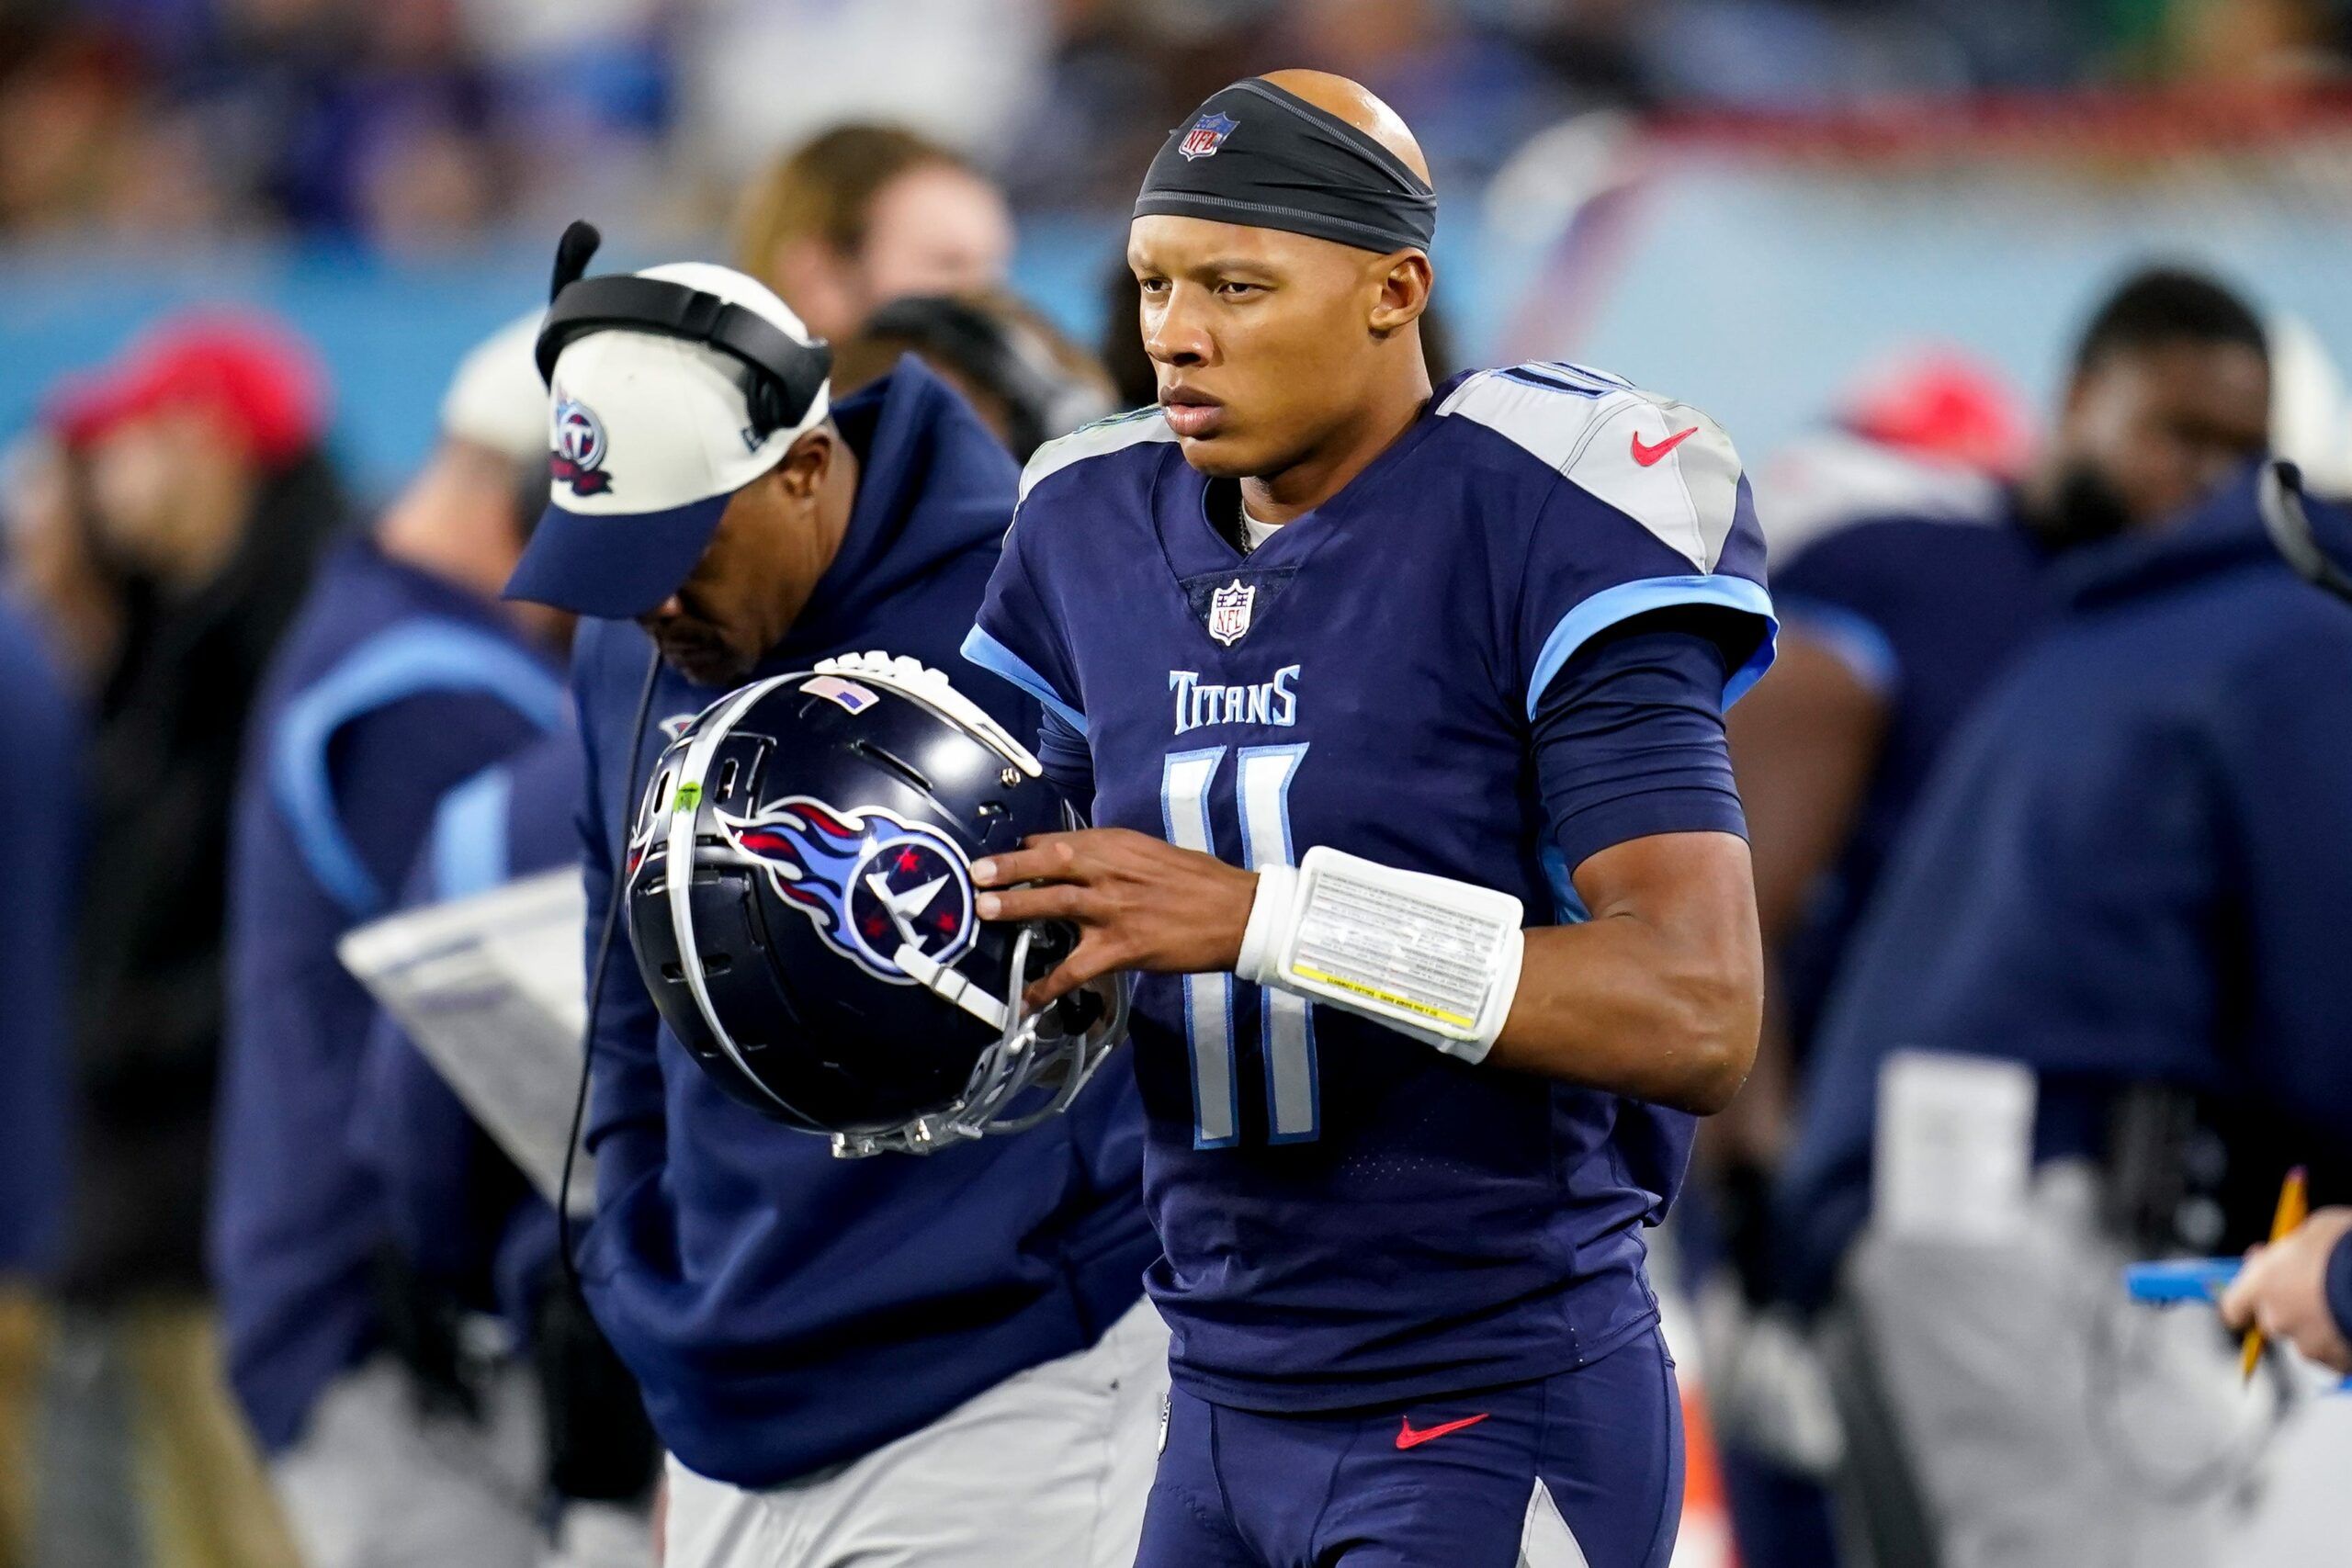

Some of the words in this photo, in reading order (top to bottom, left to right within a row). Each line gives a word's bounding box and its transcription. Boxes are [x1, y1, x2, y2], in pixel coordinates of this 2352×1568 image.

[1184, 130, 1218, 152] NFL
[1216, 609, 1241, 633] NFL
[1169, 664, 1301, 735] TITANS
[1160, 742, 1321, 1151] 11
